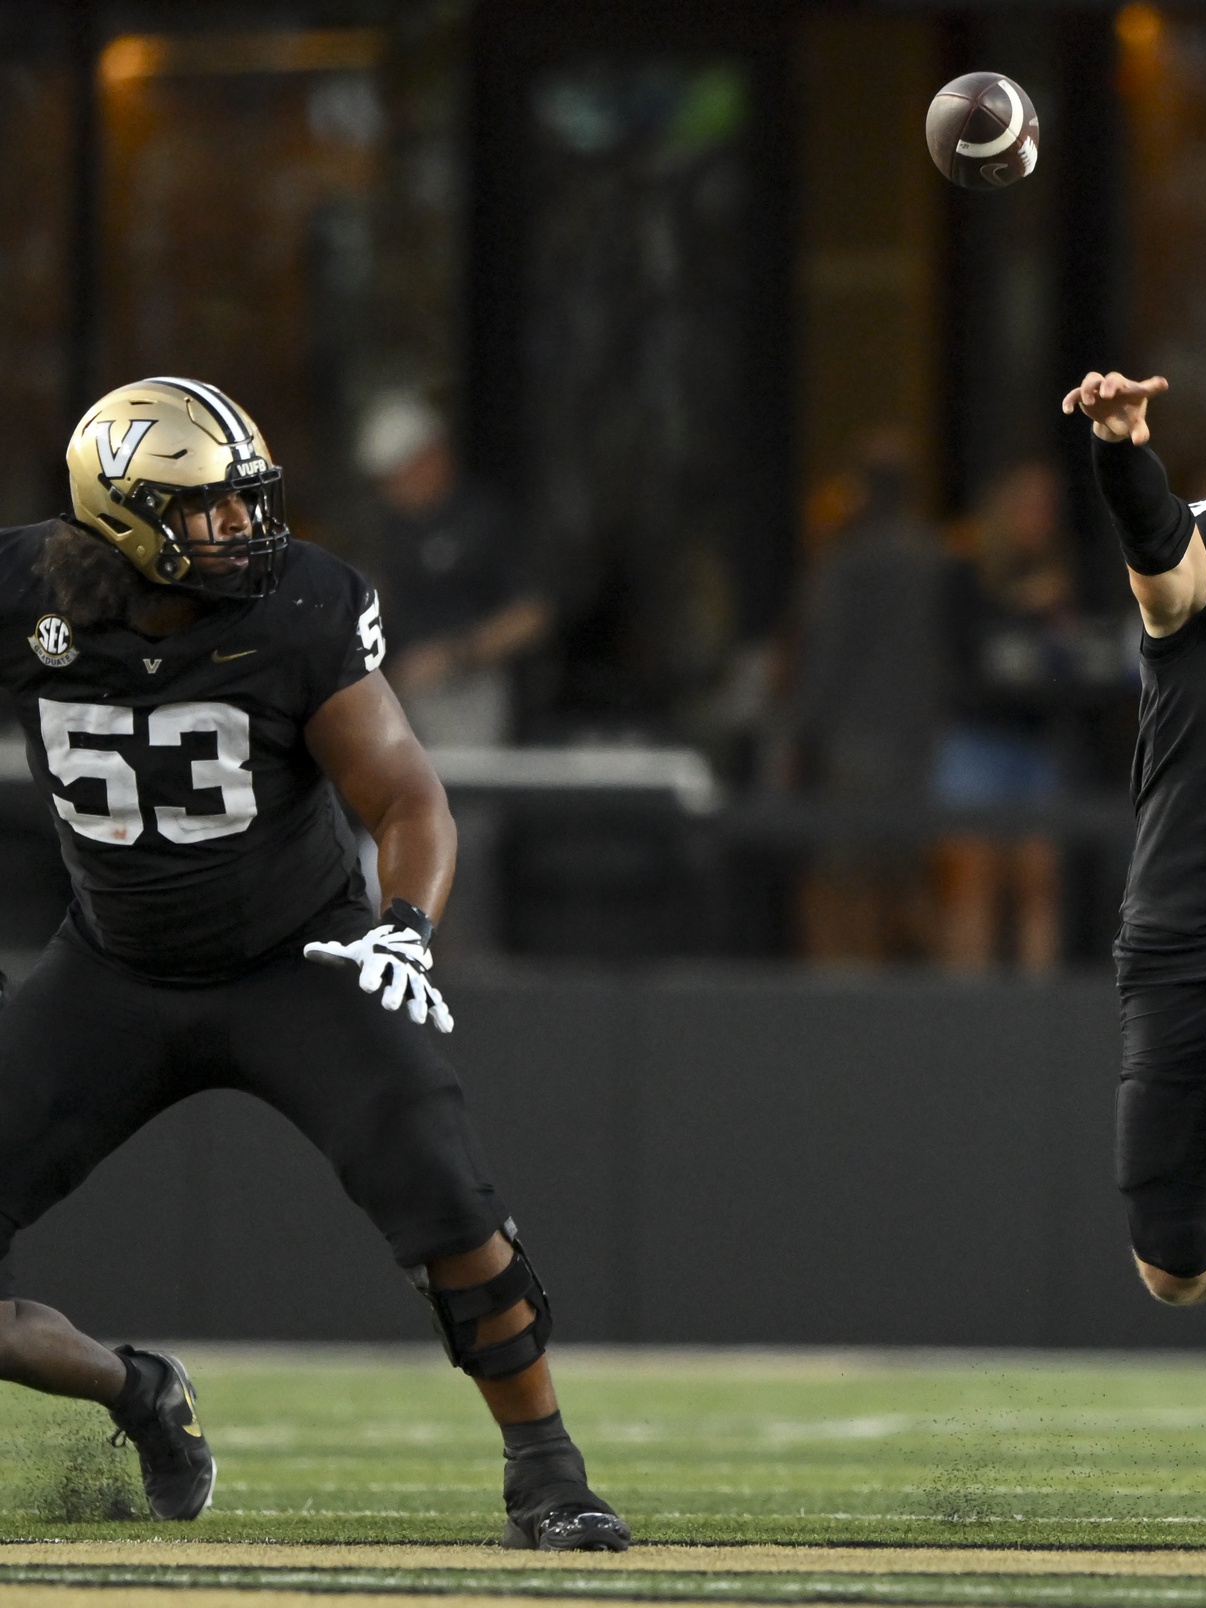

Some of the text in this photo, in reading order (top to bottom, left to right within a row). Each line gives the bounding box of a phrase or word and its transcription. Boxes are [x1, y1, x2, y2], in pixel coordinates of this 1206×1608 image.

[96, 419, 159, 479] V
[236, 459, 267, 477] VUFB
[38, 617, 70, 655] SEC
[33, 645, 72, 666] GRADUATE
[142, 658, 162, 674] V
[38, 698, 258, 846] 53
